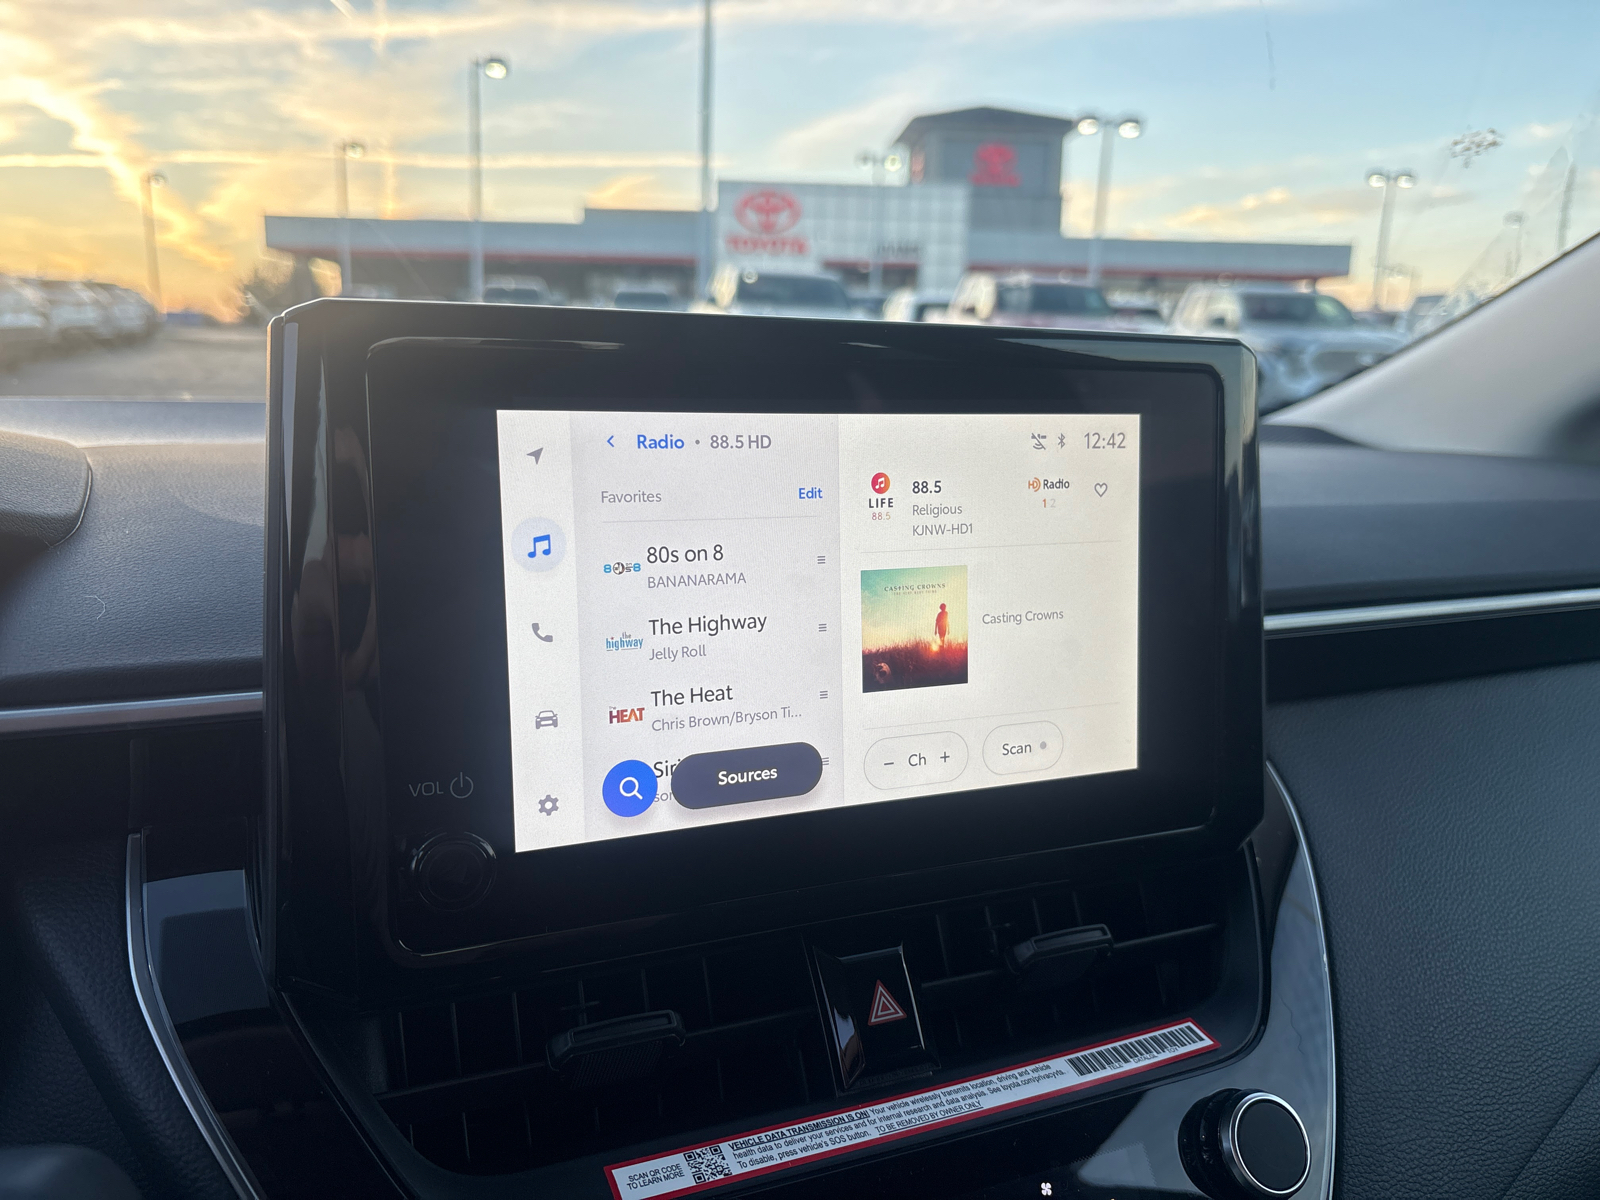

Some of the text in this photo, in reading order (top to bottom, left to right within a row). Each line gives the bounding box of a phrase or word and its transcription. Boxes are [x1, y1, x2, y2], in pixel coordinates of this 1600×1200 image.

[636, 434, 772, 450] Radio 88.5 HD
[1084, 432, 1126, 449] 12:42
[912, 480, 942, 494] 88.5
[1043, 478, 1070, 490] Radio
[600, 489, 662, 504] Favorites
[798, 487, 823, 500] Edit
[868, 498, 894, 508] LIFE
[912, 503, 963, 518] Religious
[872, 512, 891, 520] 88.5
[912, 523, 973, 536] KJNW-HD1
[646, 544, 724, 564] 80s on 8
[647, 572, 747, 589] BANANARAMA
[649, 614, 767, 637] The Highway
[982, 610, 1064, 625] Casting Crowns
[605, 636, 644, 651] highway
[649, 644, 707, 663] Jelly Roll
[651, 685, 733, 707] The Heat
[609, 707, 645, 724] HEAT
[651, 717, 685, 732] Chris
[689, 708, 777, 729] Brown/Bryson
[1002, 743, 1032, 756] Scan
[653, 759, 681, 778] Sir
[908, 753, 927, 767] Ch
[717, 767, 778, 785] Sources
[408, 781, 444, 797] VOL
[727, 1064, 1051, 1150] VEHICLE DATA TRANSMISSION IS ON! Your vehicle wirelessly transmits location, driving and vehicle
[732, 1148, 756, 1159] health
[756, 1144, 774, 1153] data
[783, 1136, 807, 1147] deliver
[807, 1131, 823, 1142] your
[824, 1124, 853, 1136] services
[853, 1119, 867, 1129] and
[876, 1110, 903, 1122] internal
[903, 1104, 932, 1116] research
[931, 1099, 945, 1109] and
[945, 1097, 960, 1105] data
[986, 1086, 1001, 1094] See
[874, 1099, 981, 1133] TO BE REMOVED BY OWNER ONLY
[736, 1130, 871, 1169] To disable, press vehicle's SOS button.
[626, 1169, 685, 1190] TO LEARN MORE
[628, 1163, 682, 1182] SCAN QR CODE
